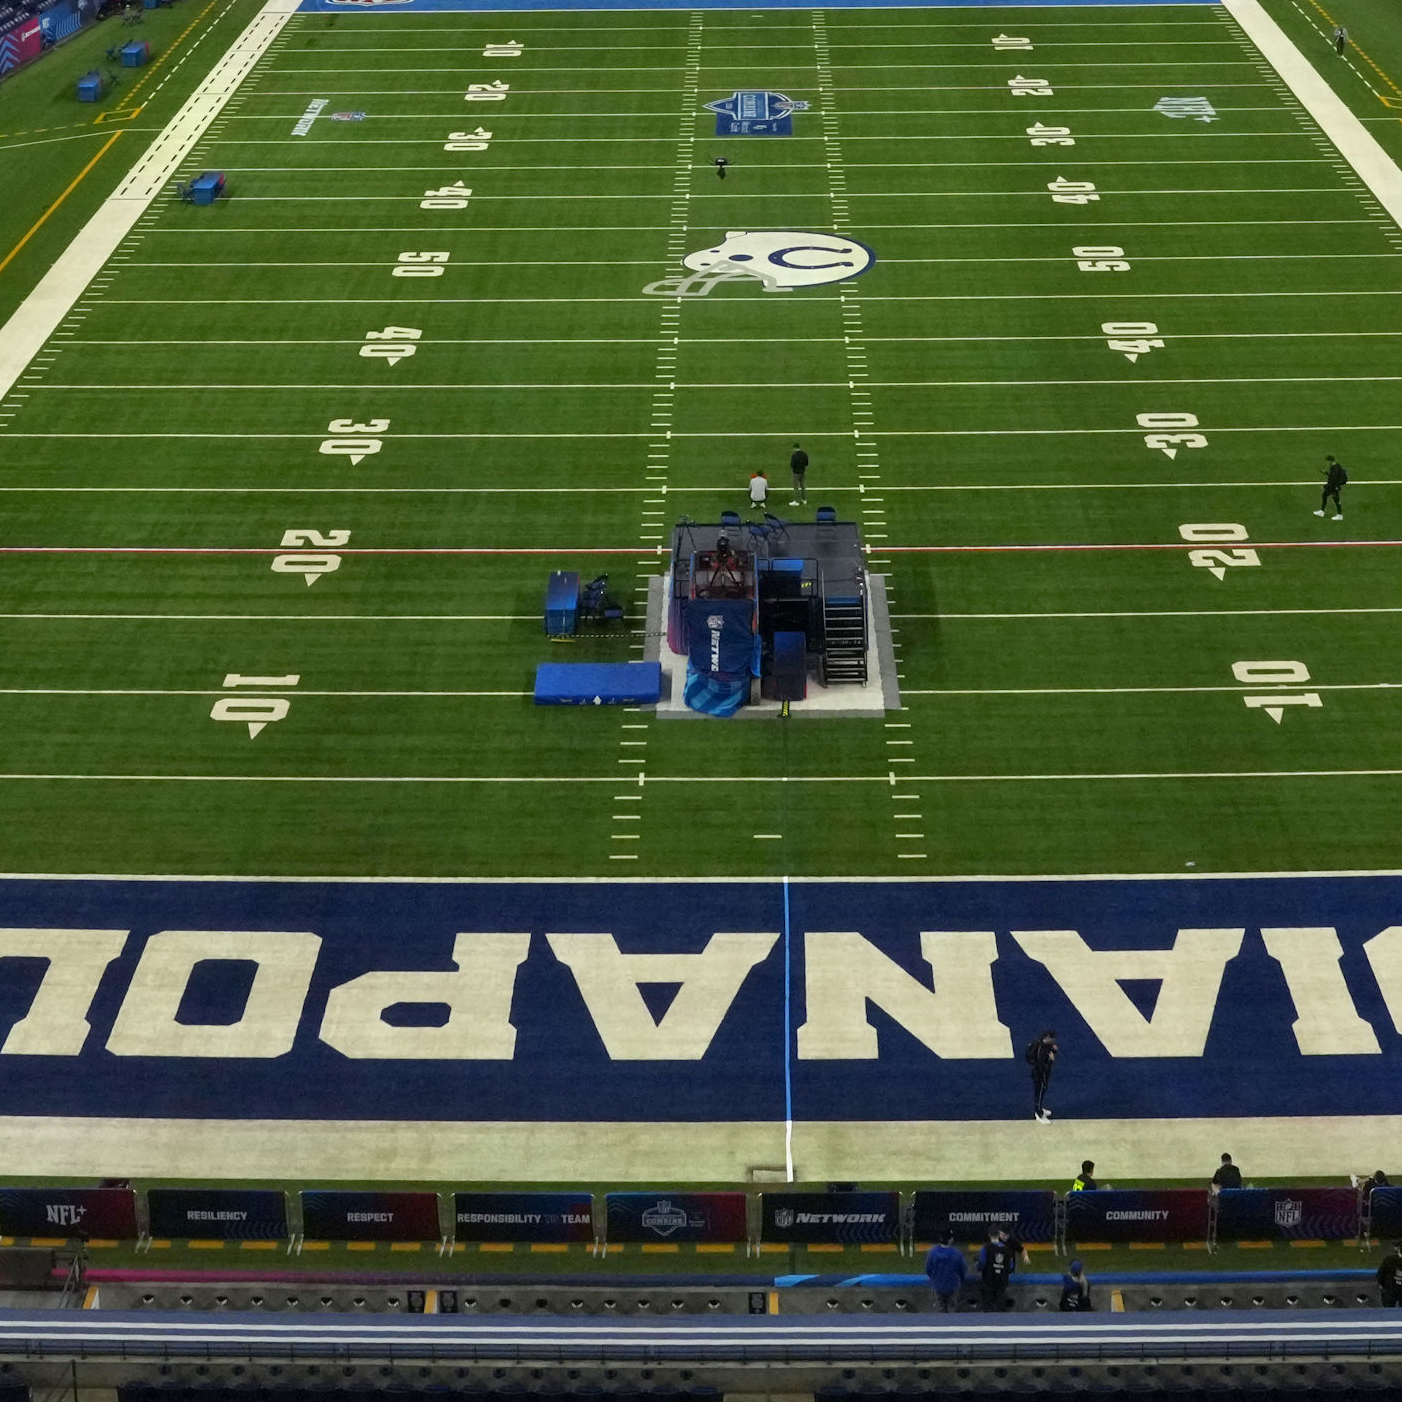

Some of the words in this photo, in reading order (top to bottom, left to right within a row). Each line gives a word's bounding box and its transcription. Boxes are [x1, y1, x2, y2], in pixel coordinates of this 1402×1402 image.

[465, 83, 510, 101] 20
[1008, 79, 1054, 96] 20
[443, 131, 493, 151] 30
[1026, 126, 1076, 146] 30
[419, 186, 473, 209] 40
[1047, 182, 1101, 205] 40
[391, 251, 451, 277] 50
[1071, 246, 1131, 271] 50
[358, 325, 423, 358] 40
[1101, 321, 1166, 354] 40
[318, 418, 392, 455] 30
[1135, 412, 1209, 449] 30
[270, 529, 352, 573] 20
[1178, 522, 1262, 567] 20
[1231, 659, 1324, 708] 10
[209, 672, 301, 721] 10
[45, 1204, 88, 1226] NFL+
[186, 1210, 248, 1222] RESILIENCY
[346, 1211, 395, 1223] RESPECT
[456, 1212, 542, 1224] RESPONSIBILITY
[560, 1213, 591, 1224] TEAM
[795, 1212, 887, 1224] NETWORK
[948, 1211, 1021, 1223] COMMITMENT
[1105, 1209, 1170, 1222] COMMUNITY
